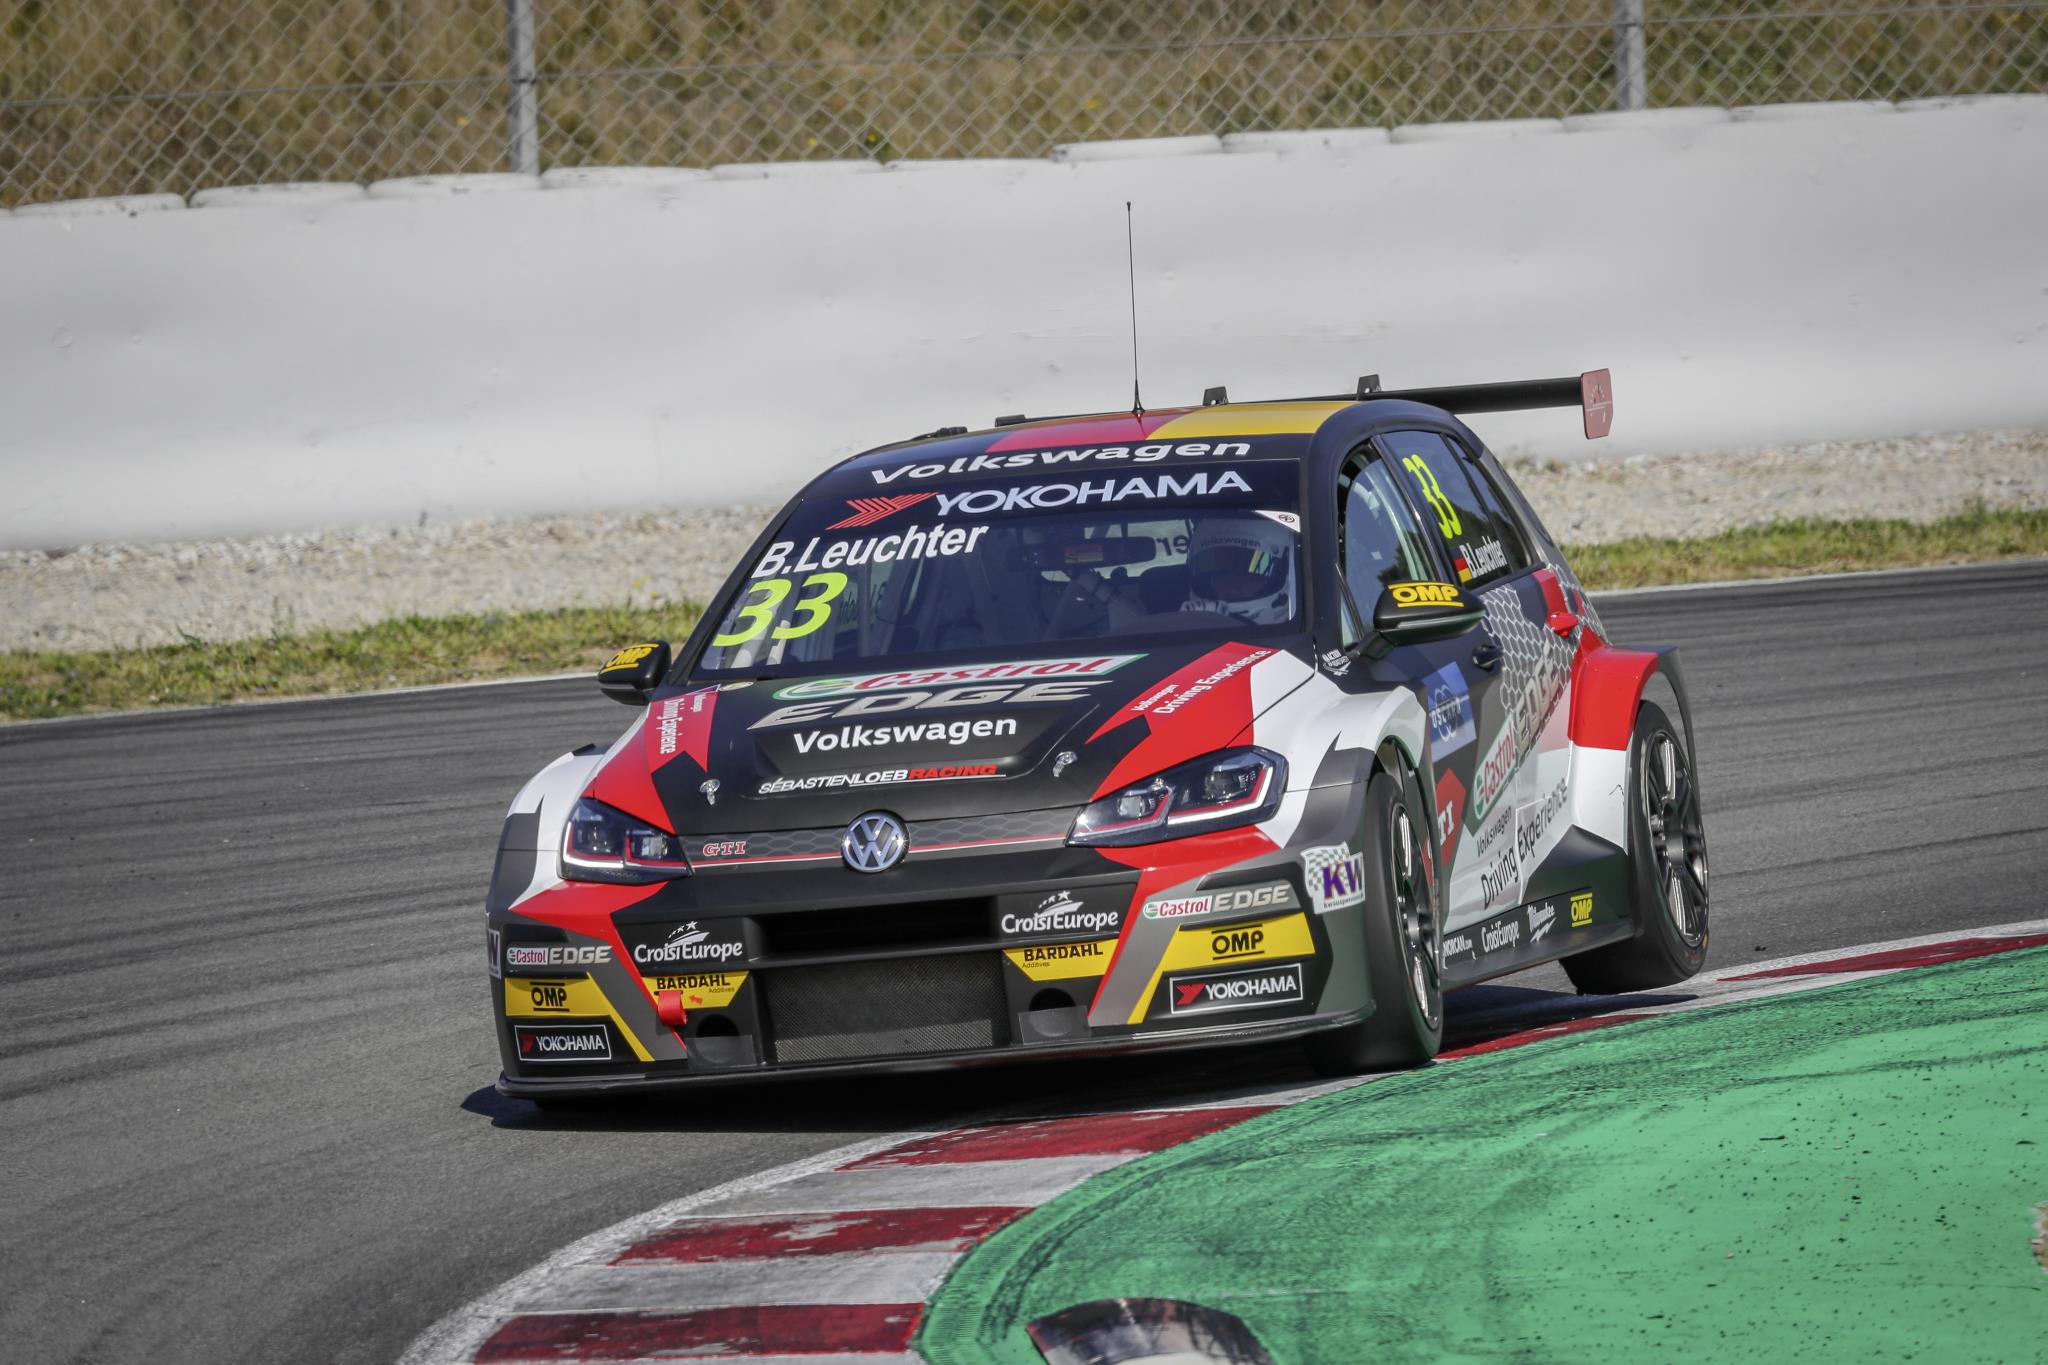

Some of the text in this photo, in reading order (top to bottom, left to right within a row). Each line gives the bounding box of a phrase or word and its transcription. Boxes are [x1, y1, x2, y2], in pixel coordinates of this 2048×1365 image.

[871, 441, 1252, 485] Volkswagen
[936, 470, 1253, 516] YOKOHAMA
[1402, 454, 1462, 539] 33
[750, 523, 990, 579] B.Leuchter
[1392, 584, 1460, 603] OMP
[711, 571, 849, 647] 33
[605, 646, 654, 669] OMP
[854, 656, 1105, 691] Castrol
[747, 680, 1114, 730] EDGE
[793, 717, 1017, 754] Volkswagen
[1484, 721, 1516, 803] Castrol
[702, 840, 747, 857] GTI
[1481, 845, 1519, 910] Driving
[1158, 884, 1291, 917] Castrol EDGE
[1570, 896, 1593, 923] OMP
[1001, 911, 1119, 934] CroisiEurope
[515, 945, 613, 965] Castrol EDGE
[634, 942, 743, 963] CroisiEurope
[1023, 943, 1104, 962] BARDAHL
[1211, 930, 1265, 955] OMP
[656, 974, 731, 990] BARDAHL
[1205, 974, 1297, 1001] YOKOHAMA
[531, 987, 568, 1007] OMP
[536, 1034, 606, 1052] YOKOHAMA
